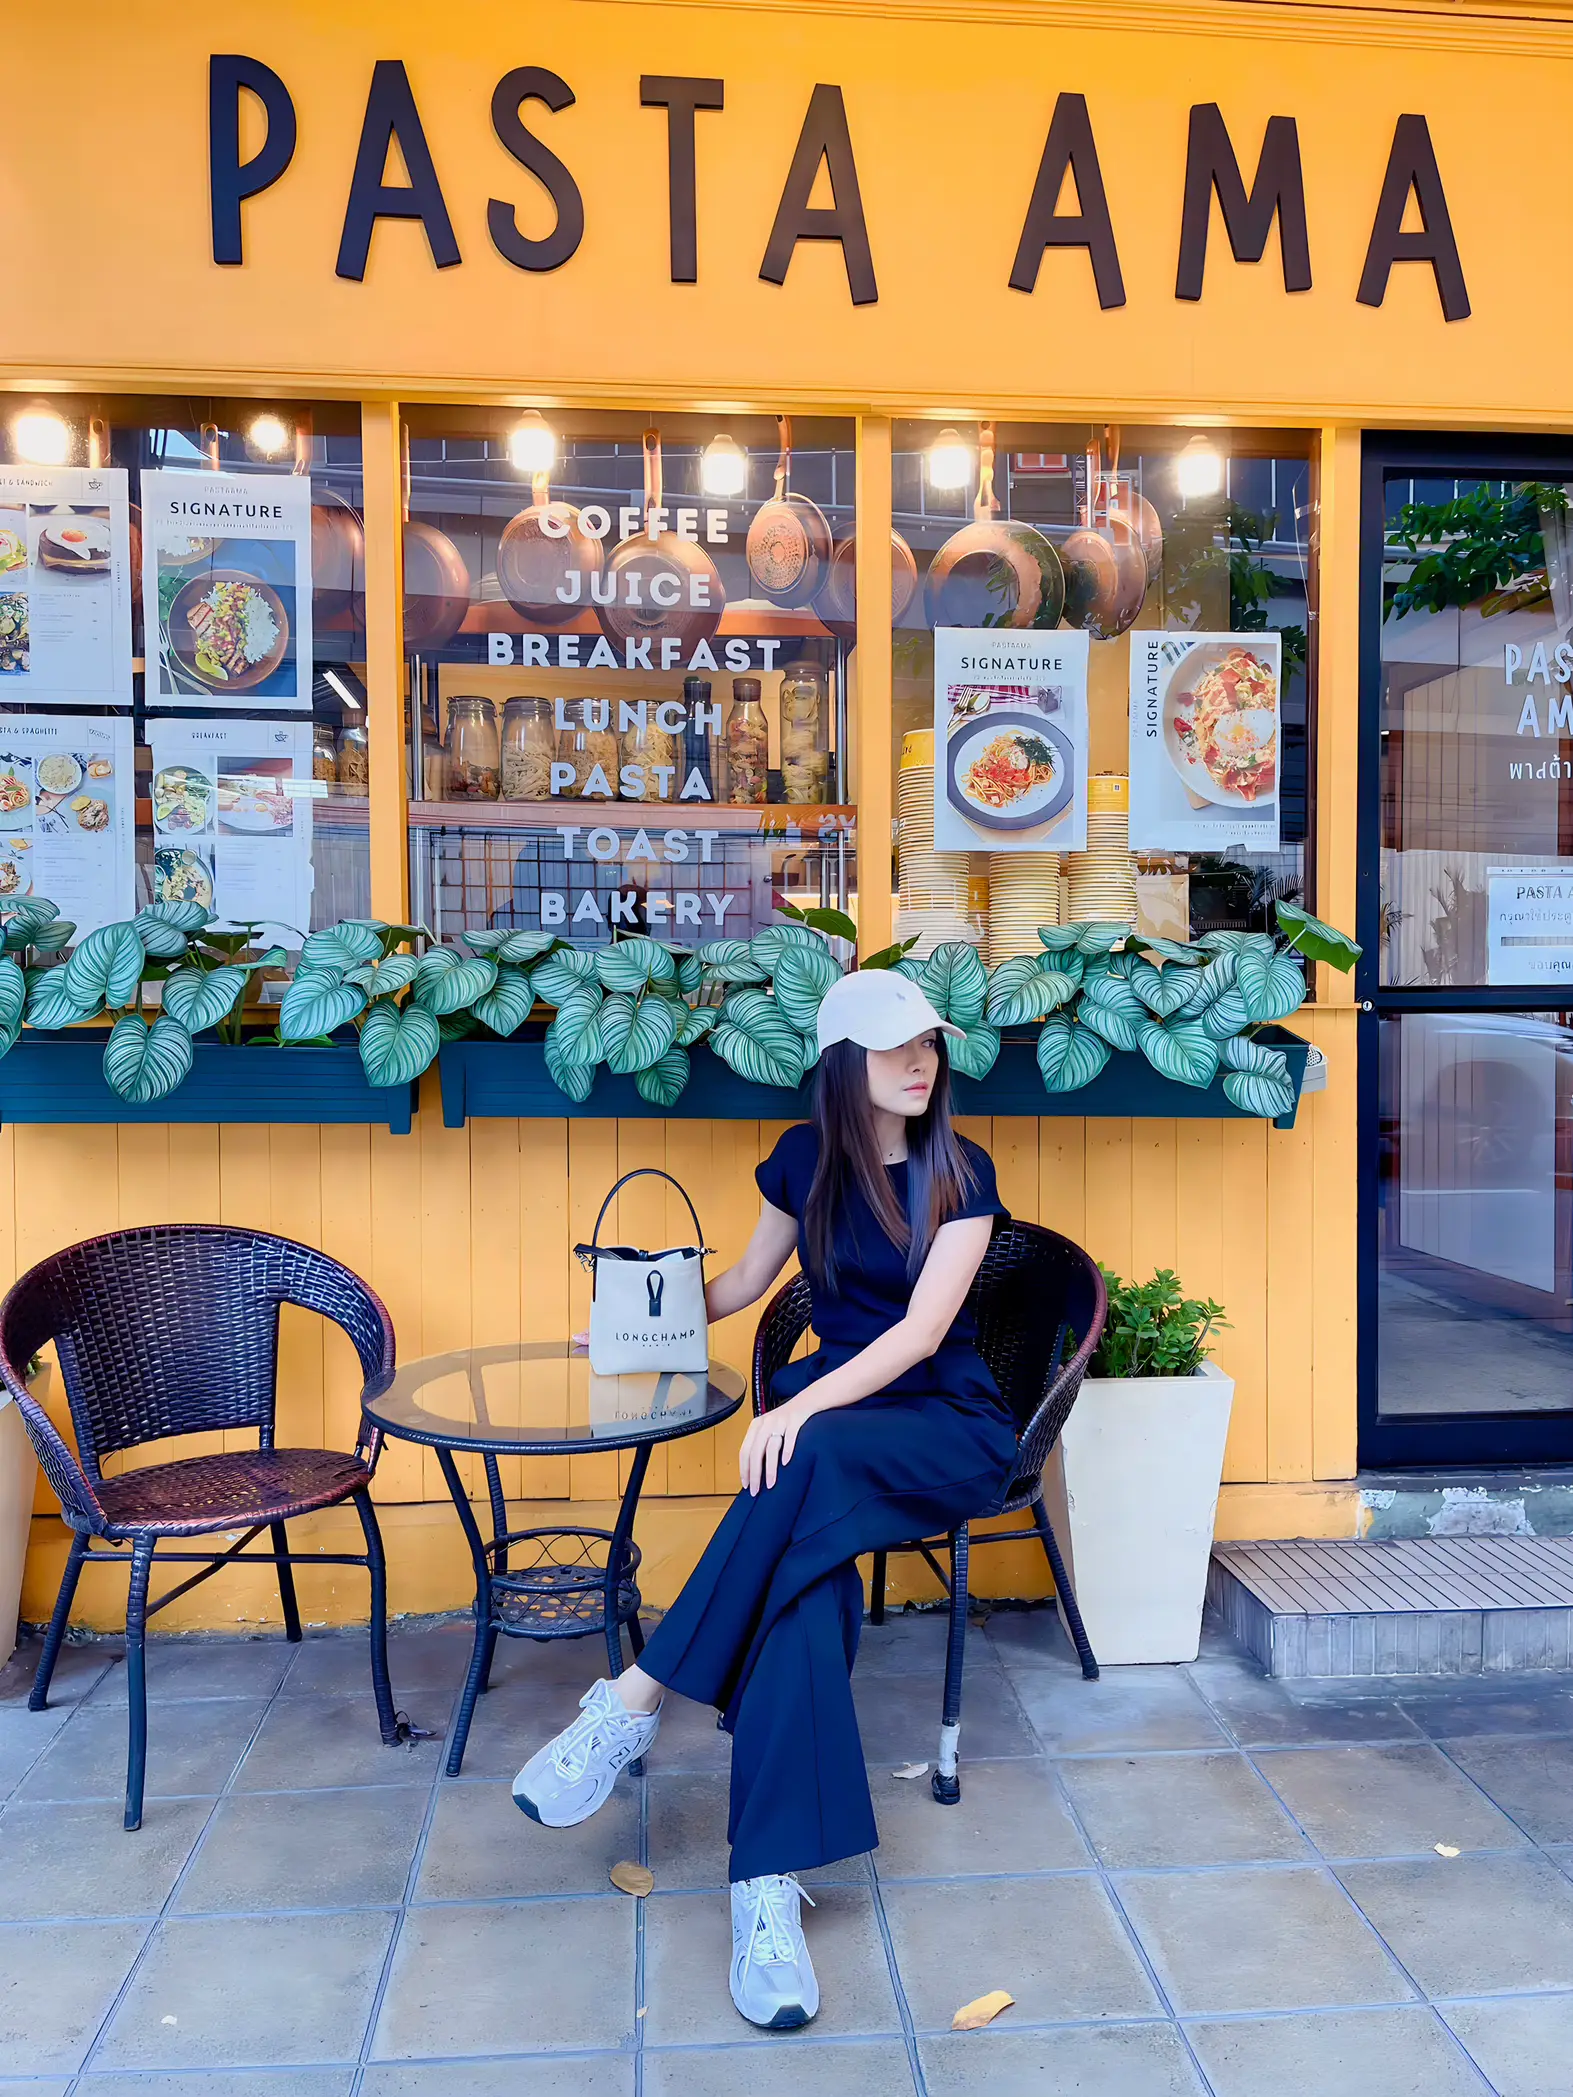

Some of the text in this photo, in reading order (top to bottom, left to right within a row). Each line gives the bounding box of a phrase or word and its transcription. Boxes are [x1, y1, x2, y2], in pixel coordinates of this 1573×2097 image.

[209, 54, 1472, 322] PASTA AMA
[170, 501, 283, 519] SIGNATURE
[537, 505, 730, 544] COFFEE
[556, 569, 712, 608] JUICE
[488, 632, 782, 673] BREAKFAST
[961, 657, 1063, 671] SIGNATURE
[1505, 641, 1573, 686] PAS
[1146, 641, 1159, 738] SIGNATURE
[555, 697, 723, 737] LUNCH
[1516, 694, 1573, 738] AM
[550, 762, 712, 801] PASTA
[556, 826, 719, 863] TOAST
[540, 891, 736, 926] BAKERY
[1516, 885, 1563, 900] PASTA
[615, 1329, 696, 1343] LONGCHAMP
